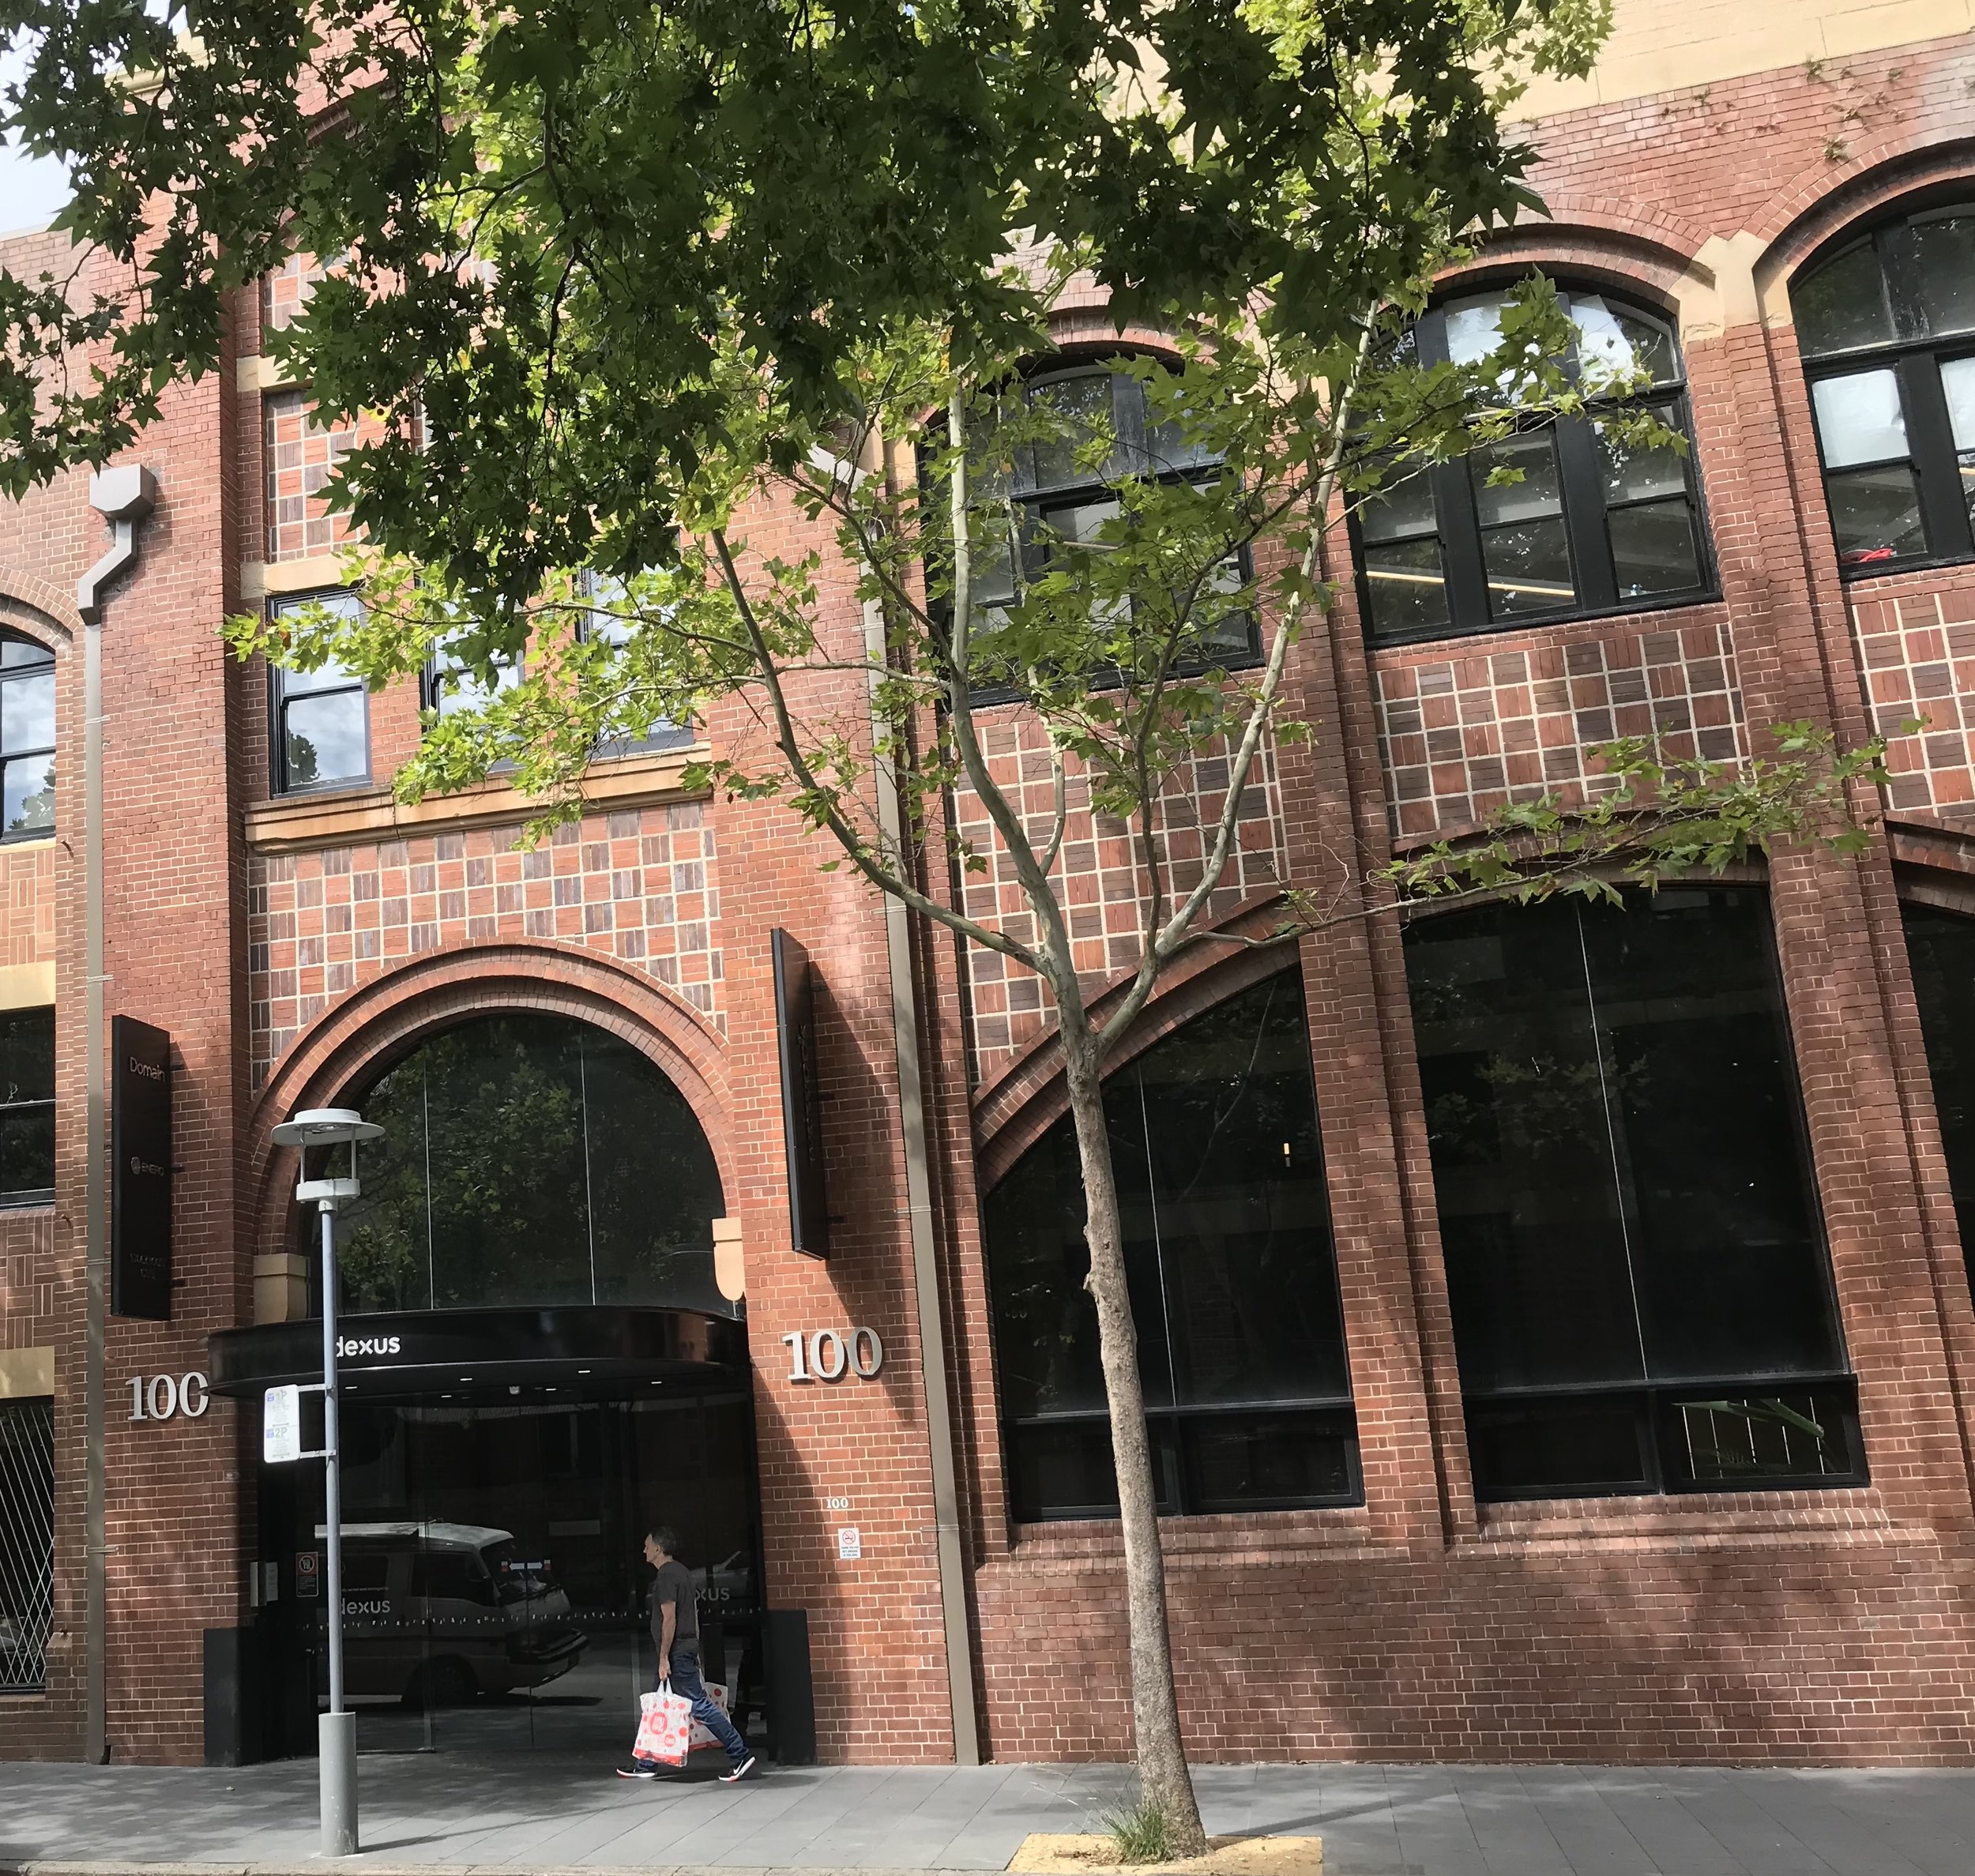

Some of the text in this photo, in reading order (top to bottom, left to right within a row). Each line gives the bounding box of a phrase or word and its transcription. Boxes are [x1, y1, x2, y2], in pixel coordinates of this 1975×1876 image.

[130, 1055, 165, 1083] Domain
[336, 1336, 401, 1358] dexus
[782, 1325, 882, 1380] 100
[125, 1371, 209, 1420] 100
[275, 1427, 288, 1438] 2P
[826, 1497, 849, 1509] 100
[695, 1588, 730, 1601] xus
